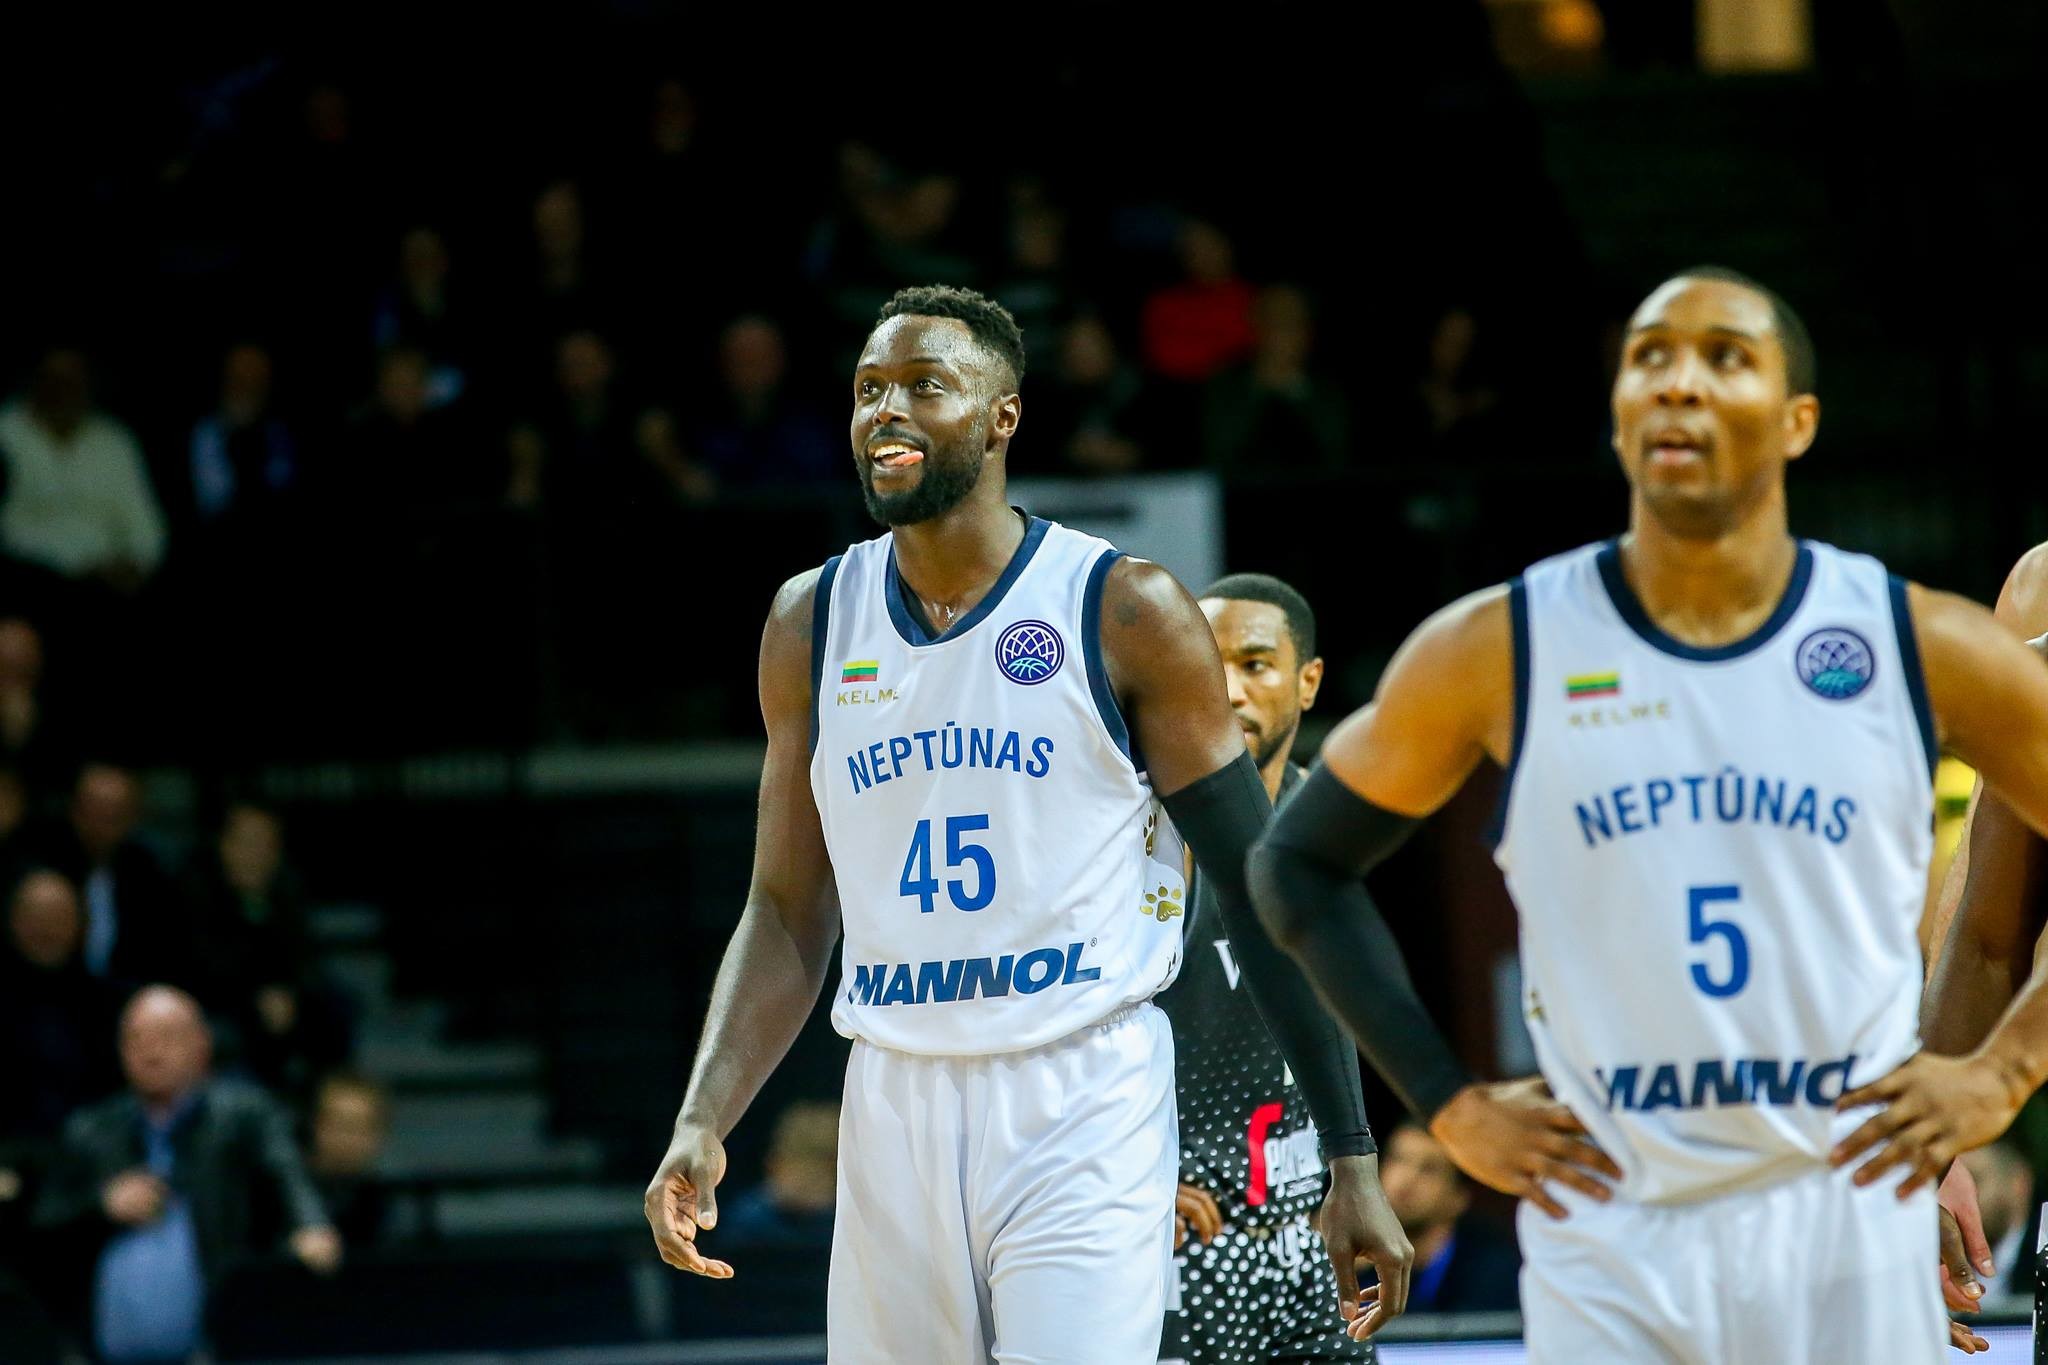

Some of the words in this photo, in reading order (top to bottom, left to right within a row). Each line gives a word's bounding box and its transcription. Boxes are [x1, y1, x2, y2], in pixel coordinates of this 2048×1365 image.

[847, 721, 1055, 795] NEPTŪNAS
[899, 813, 996, 914] 45
[1687, 885, 1750, 1000] 5
